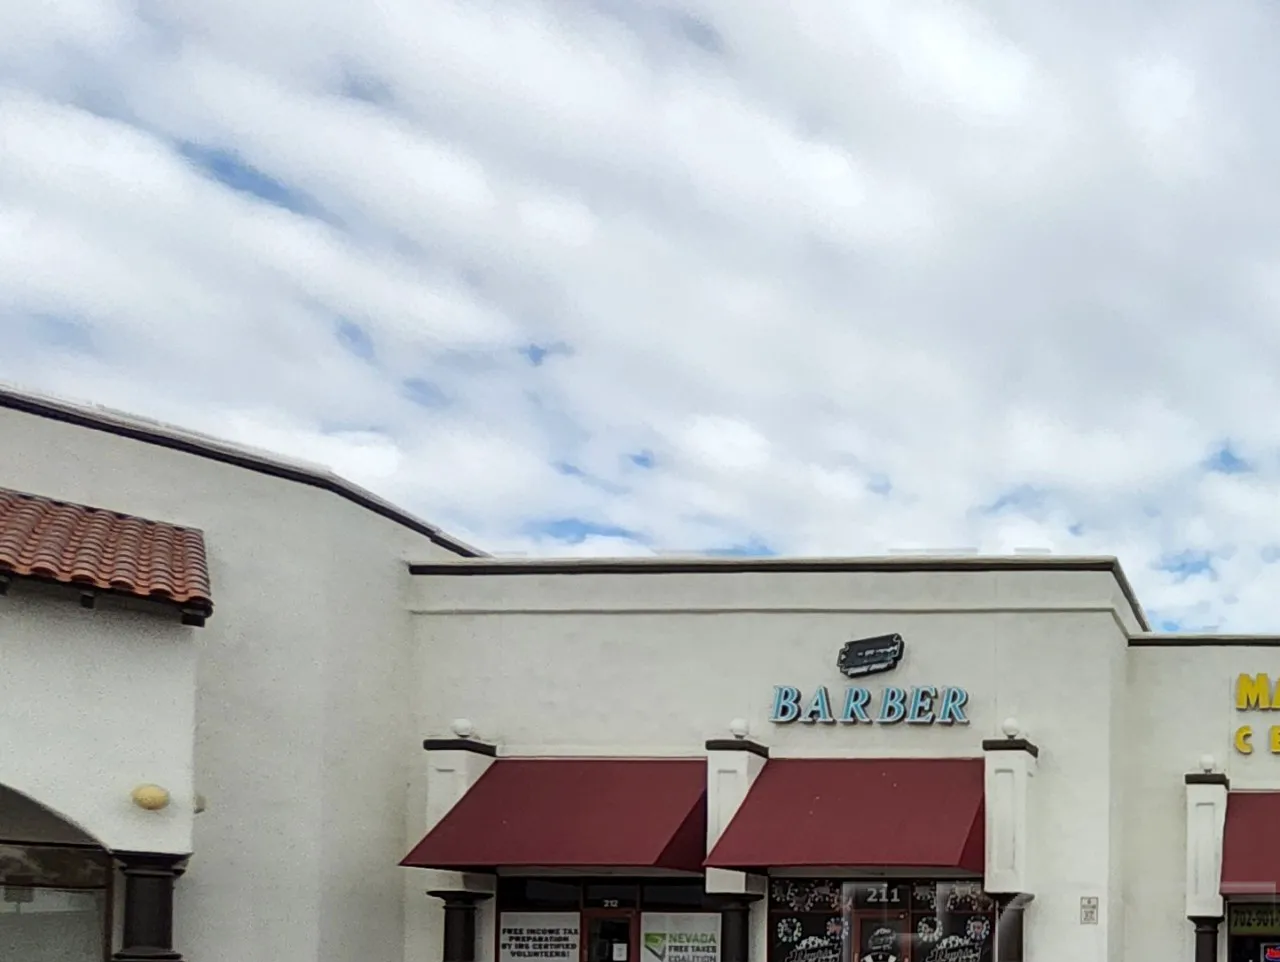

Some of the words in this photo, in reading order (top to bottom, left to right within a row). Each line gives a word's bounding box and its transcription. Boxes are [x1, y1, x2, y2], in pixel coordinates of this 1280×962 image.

[768, 685, 970, 725] BARBER
[867, 888, 901, 902] 211
[603, 899, 618, 907] 212
[668, 933, 717, 943] NEVADA
[668, 945, 688, 953] FREE
[691, 945, 717, 953] TAXES
[668, 955, 717, 962] COALITION
